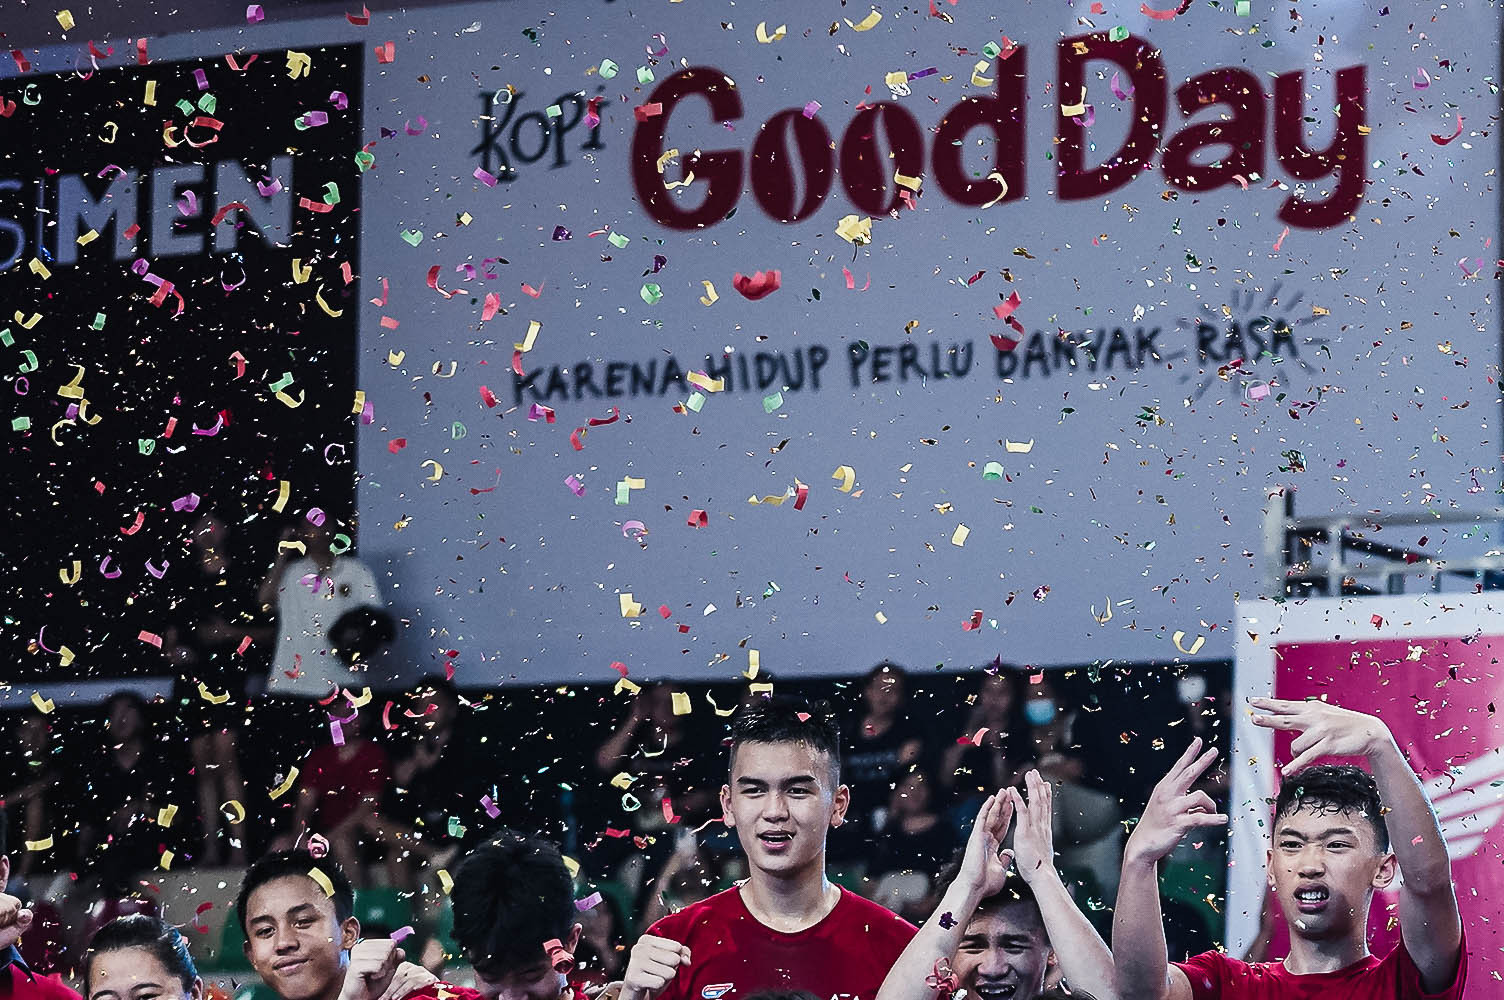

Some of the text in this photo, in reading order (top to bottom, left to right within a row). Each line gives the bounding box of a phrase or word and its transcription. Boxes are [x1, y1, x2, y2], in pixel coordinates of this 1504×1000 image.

[57, 155, 293, 264] MEN
[512, 317, 1299, 403] KARENA HIDUP PERLU BANYAK RASA
